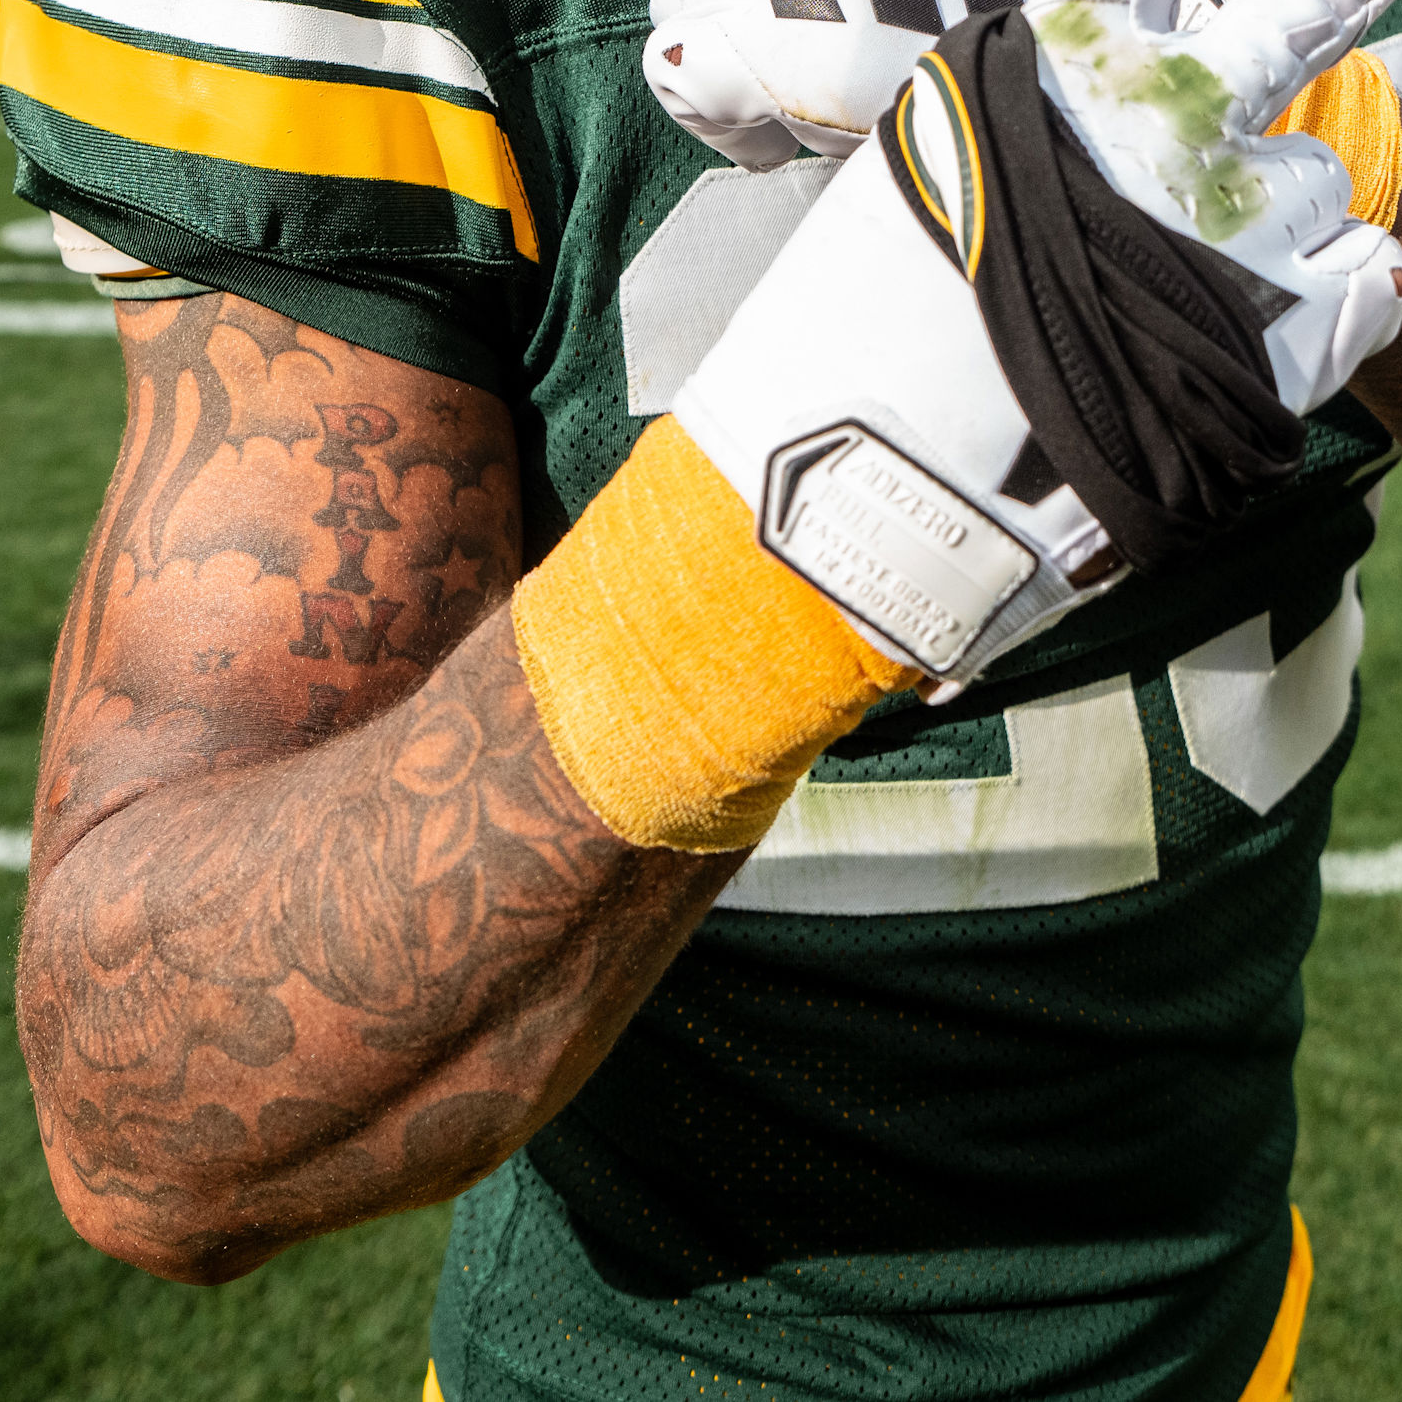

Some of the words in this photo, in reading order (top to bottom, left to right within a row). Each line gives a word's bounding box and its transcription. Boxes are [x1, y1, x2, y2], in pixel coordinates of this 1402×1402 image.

[845, 451, 973, 553] ADIZERO
[801, 512, 895, 587] FASTEST
[842, 570, 945, 652] FOOTBALL
